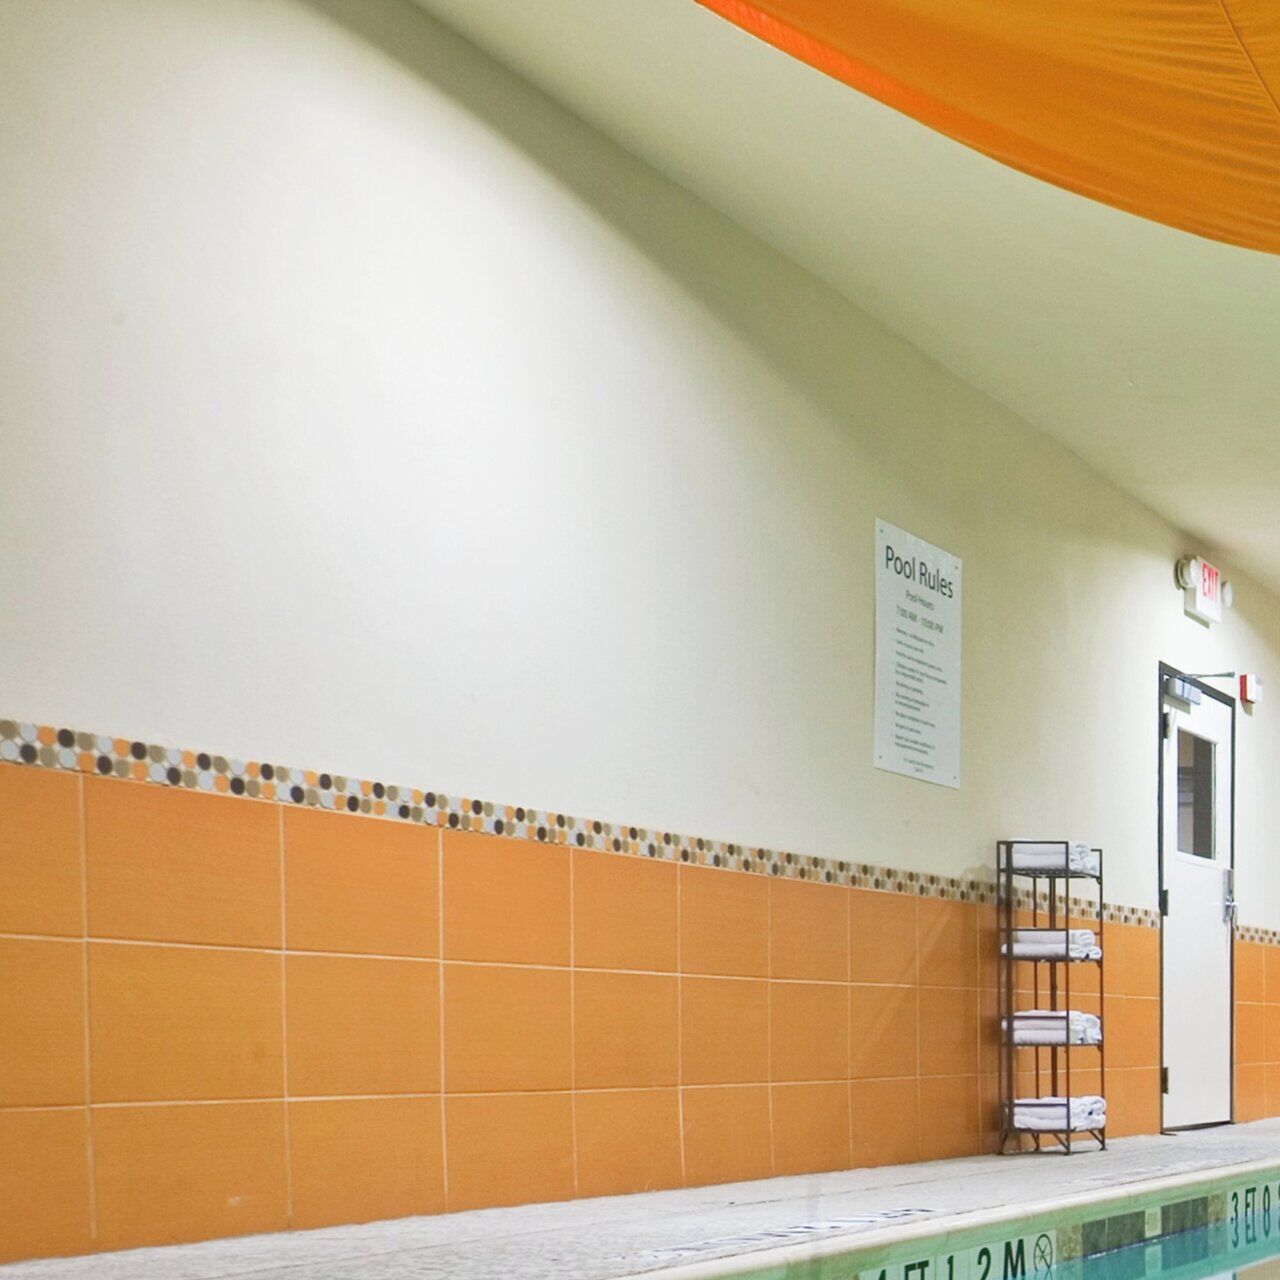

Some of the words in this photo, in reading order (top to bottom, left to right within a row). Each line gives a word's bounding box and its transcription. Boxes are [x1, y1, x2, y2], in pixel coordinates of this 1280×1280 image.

[886, 545, 916, 581] Pool
[919, 561, 953, 599] Rules
[1202, 562, 1219, 602] EXIT
[1231, 1191, 1239, 1221] 3
[1245, 1187, 1257, 1217] FT
[1003, 1239, 1026, 1280] M
